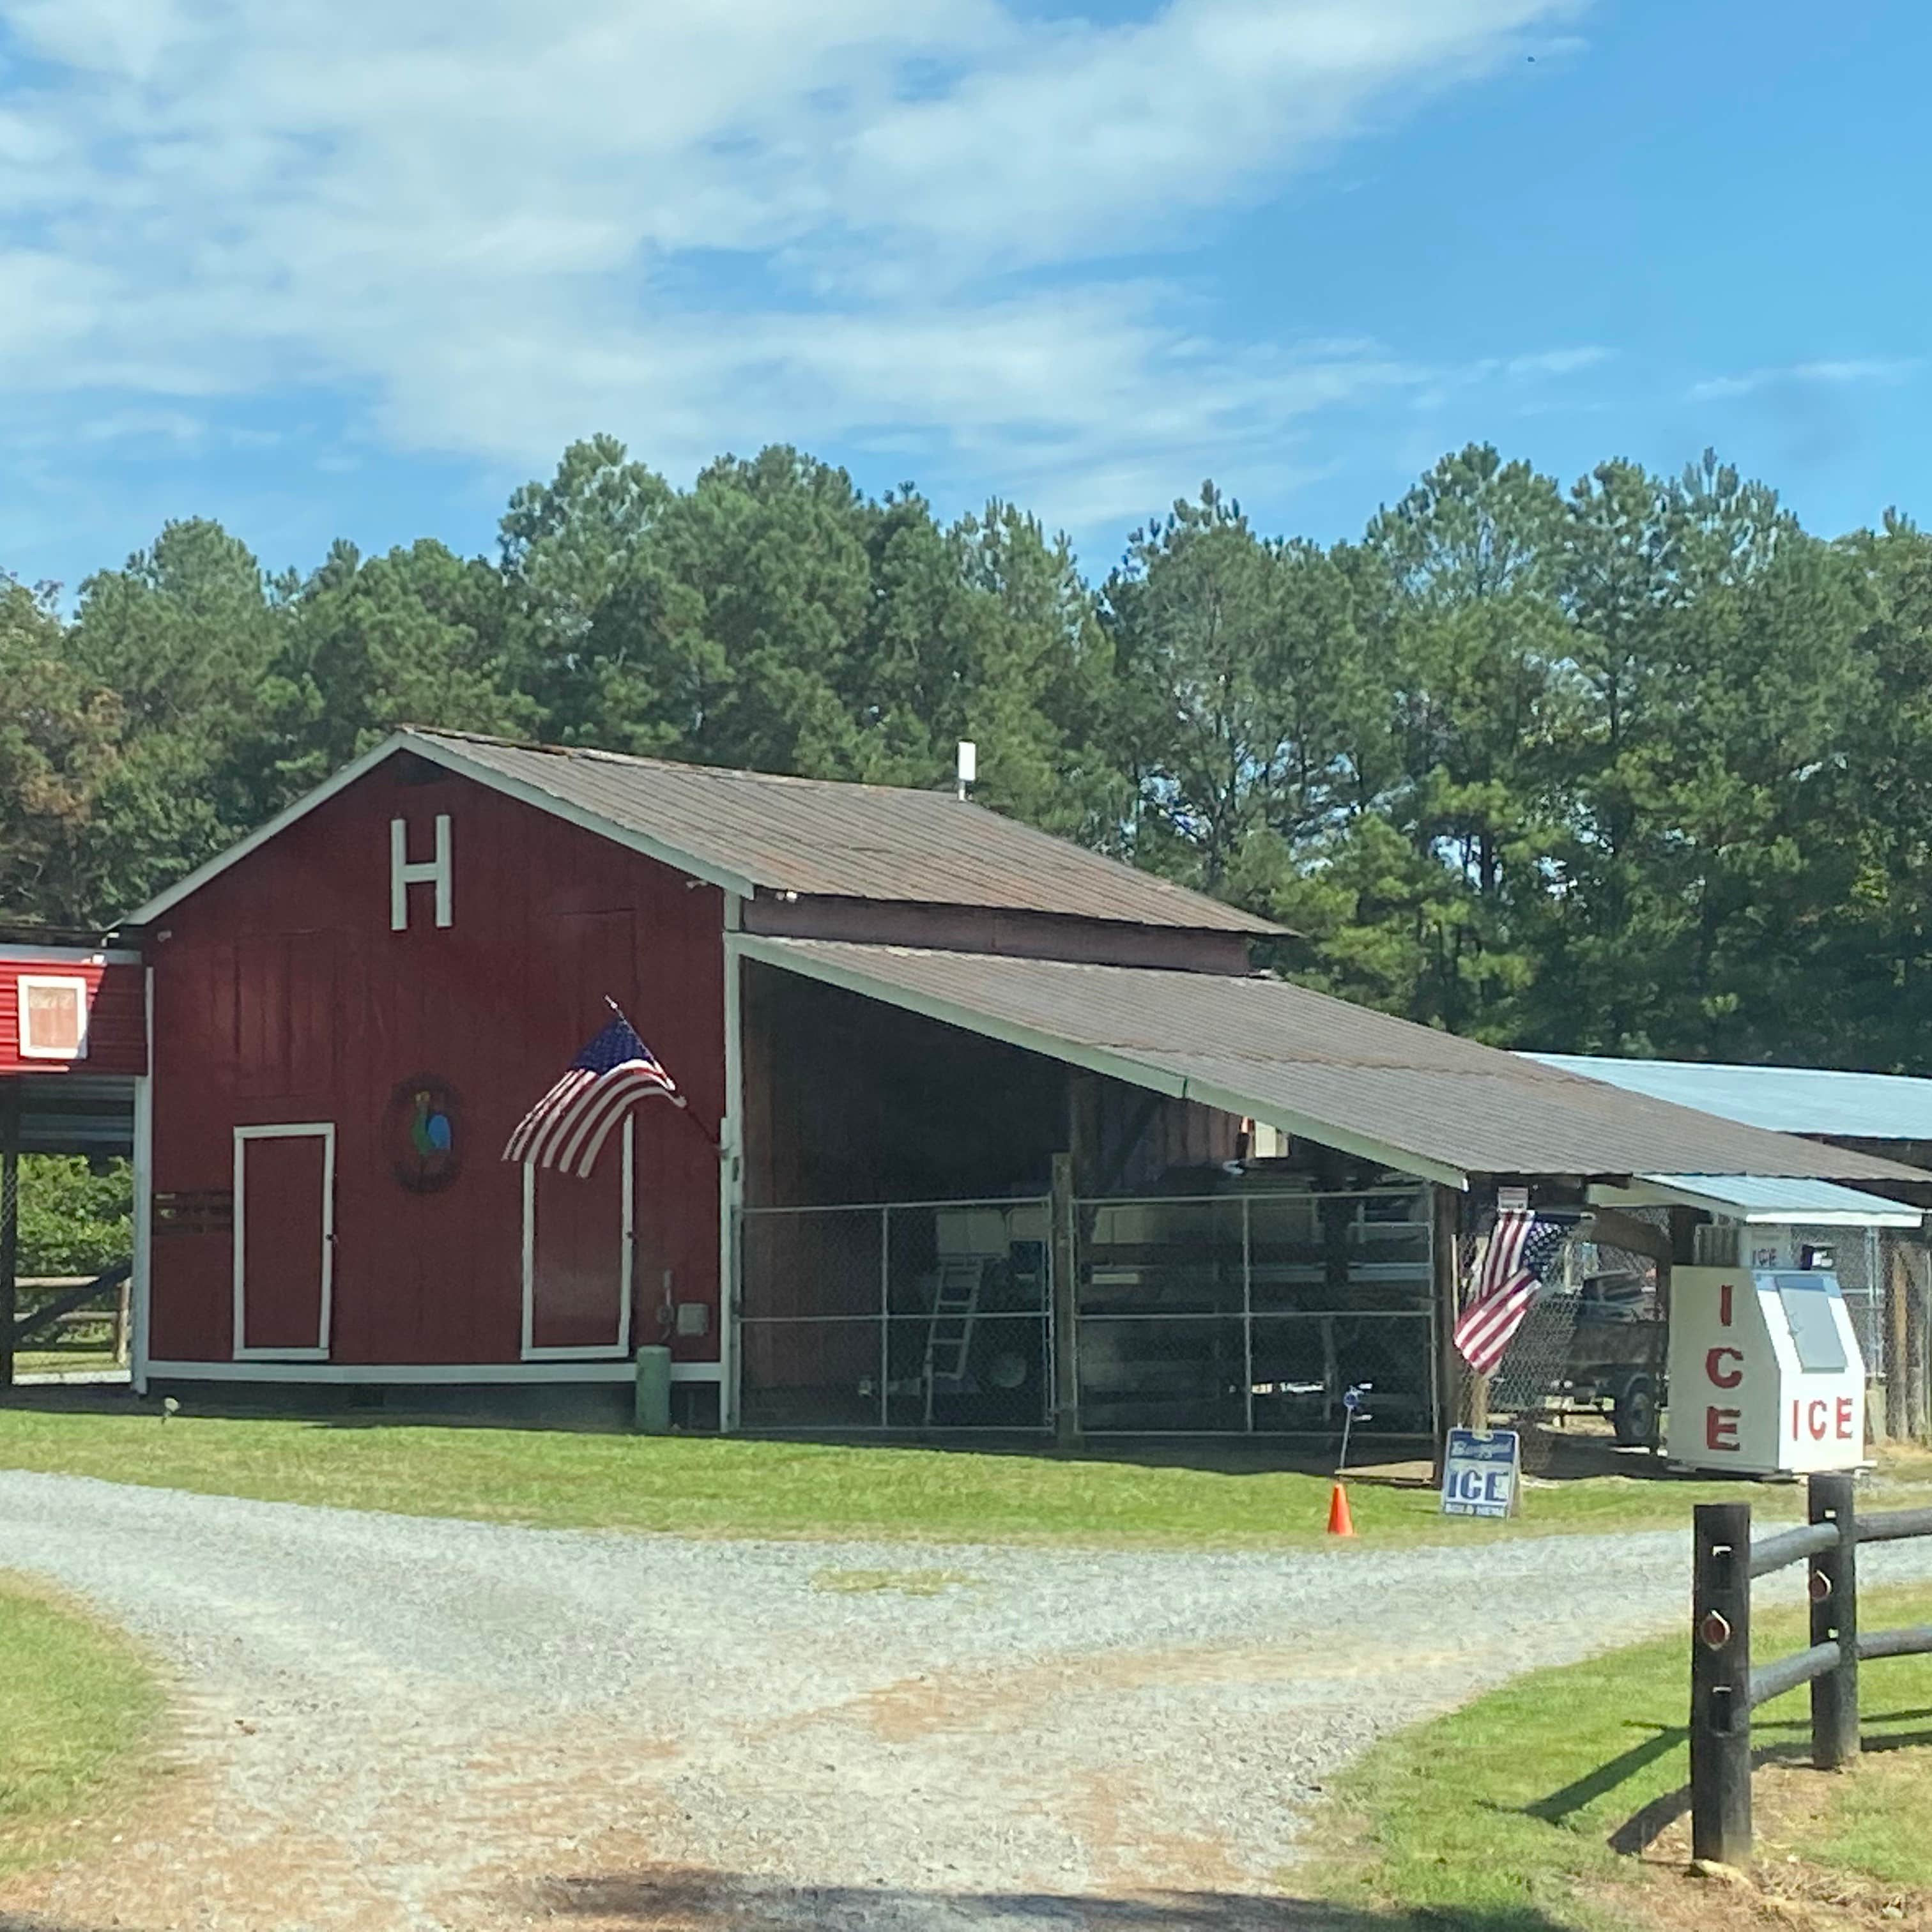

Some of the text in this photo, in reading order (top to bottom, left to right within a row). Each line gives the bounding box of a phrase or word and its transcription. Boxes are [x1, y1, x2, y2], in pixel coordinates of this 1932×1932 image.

[390, 815, 452, 930] H
[1705, 1284, 1744, 1452] ICE
[1793, 1396, 1853, 1441] ICE
[1448, 1469, 1509, 1501] ICE
